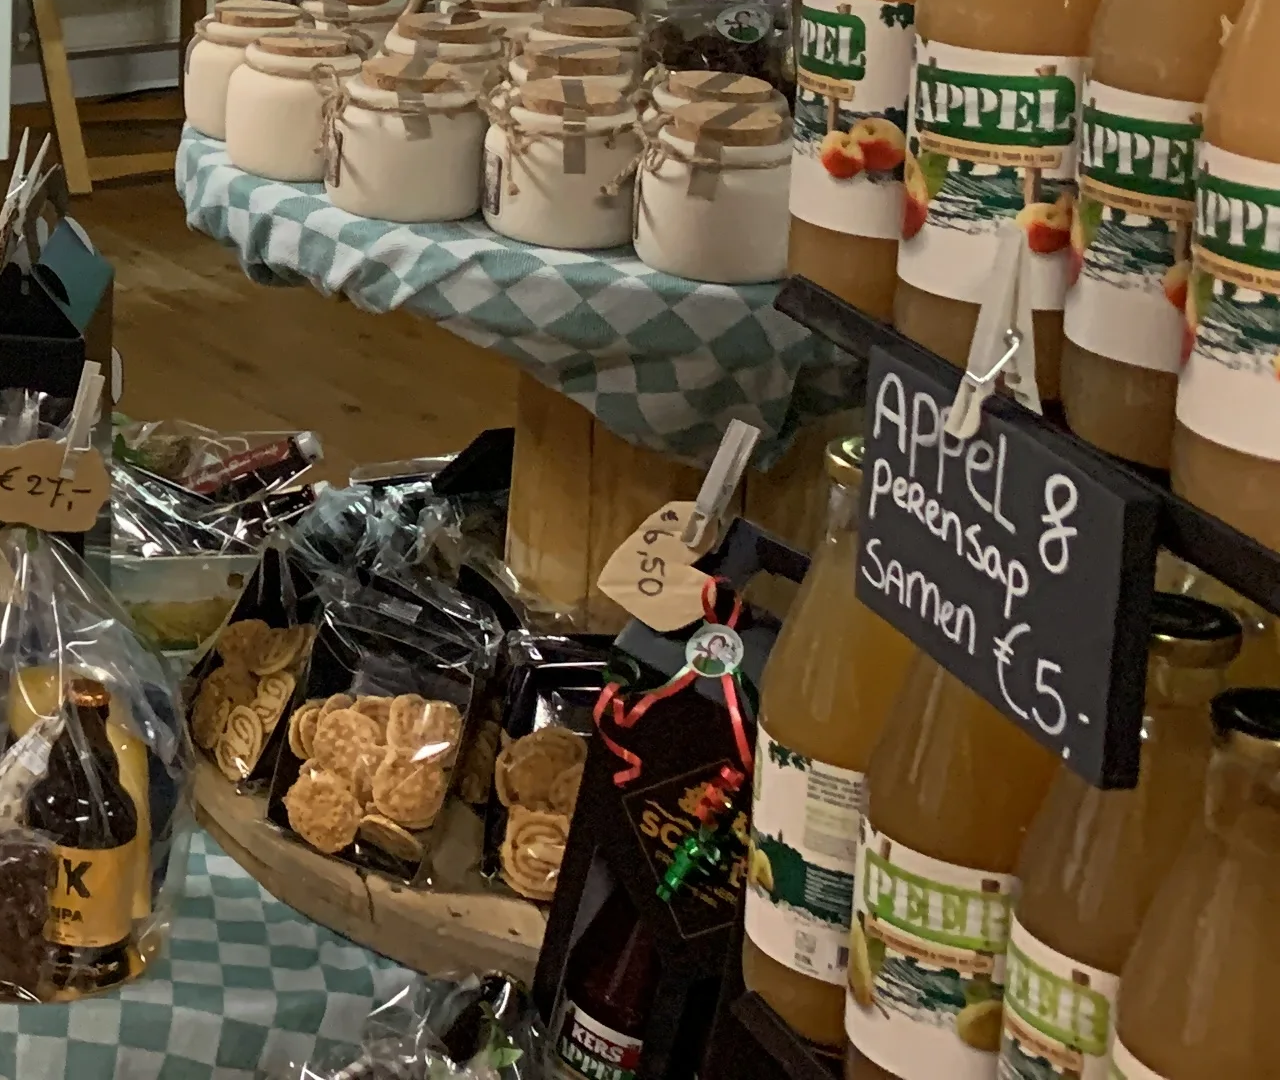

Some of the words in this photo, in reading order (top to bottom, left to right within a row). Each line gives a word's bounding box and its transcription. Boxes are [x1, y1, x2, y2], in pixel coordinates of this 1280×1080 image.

[915, 80, 1071, 133] APPEL
[1038, 473, 1078, 575] &
[571, 1020, 625, 1063] KERS
